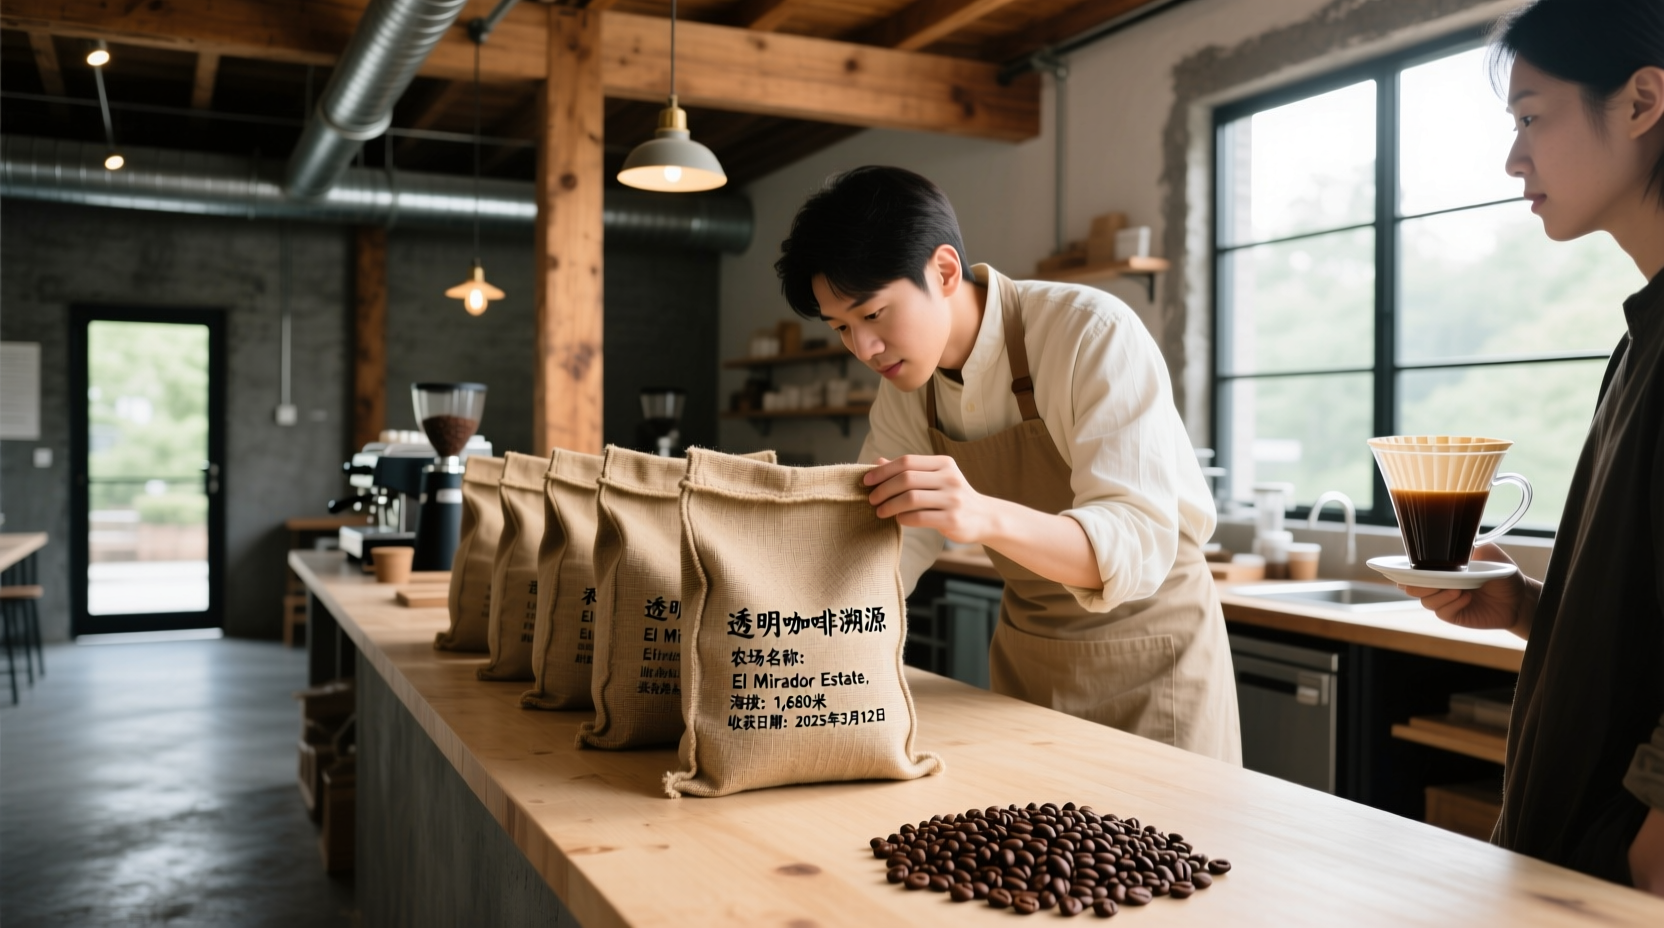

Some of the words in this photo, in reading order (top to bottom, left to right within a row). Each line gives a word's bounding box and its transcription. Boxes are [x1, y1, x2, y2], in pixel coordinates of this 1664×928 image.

[727, 606, 886, 639] 透明咖啡溯源
[732, 673, 746, 689] El
[754, 673, 815, 688] Mirador
[821, 670, 869, 687] Estate,
[774, 693, 827, 712] 1,680米
[795, 708, 885, 728] 2025年3月12日
